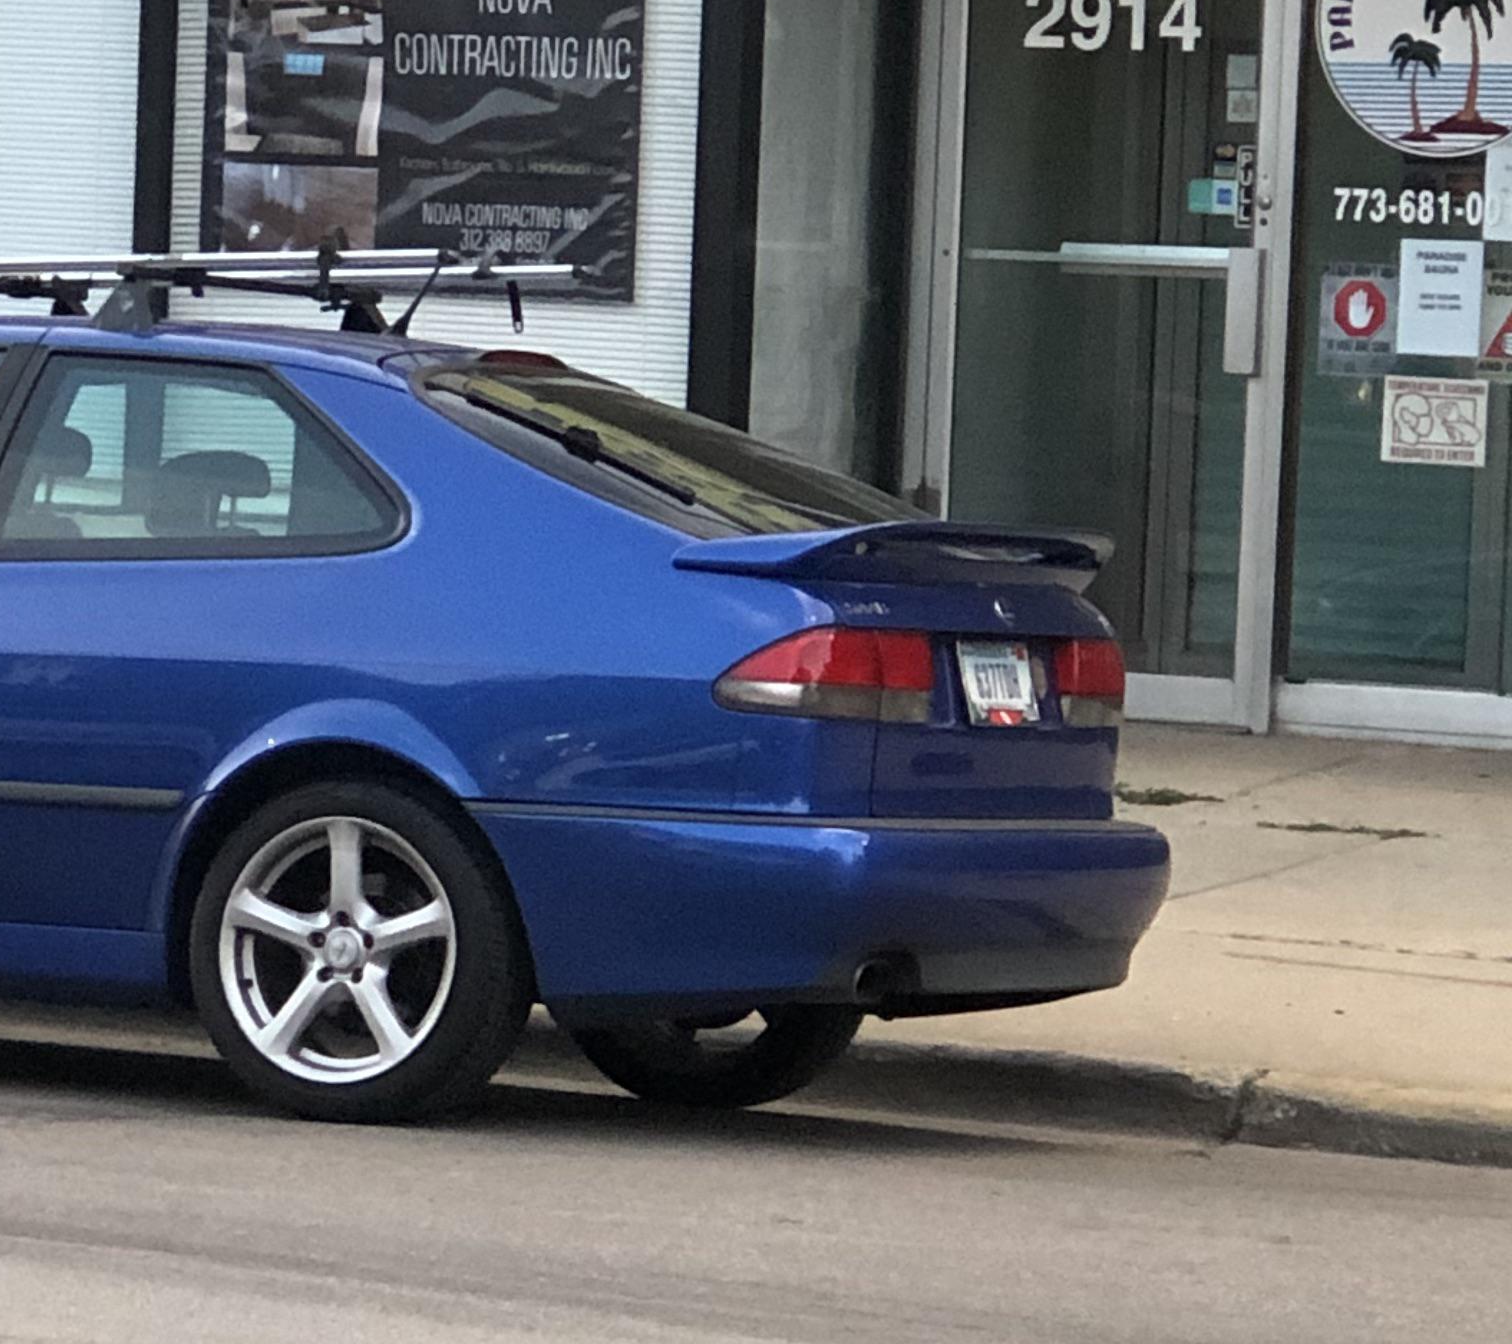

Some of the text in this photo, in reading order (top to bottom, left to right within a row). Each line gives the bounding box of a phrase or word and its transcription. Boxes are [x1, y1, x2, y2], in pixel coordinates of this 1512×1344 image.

[394, 32, 633, 81] CONTRACTING INC
[1240, 152, 1253, 223] PULL
[421, 202, 589, 232] NOVA CONTRACTING INC
